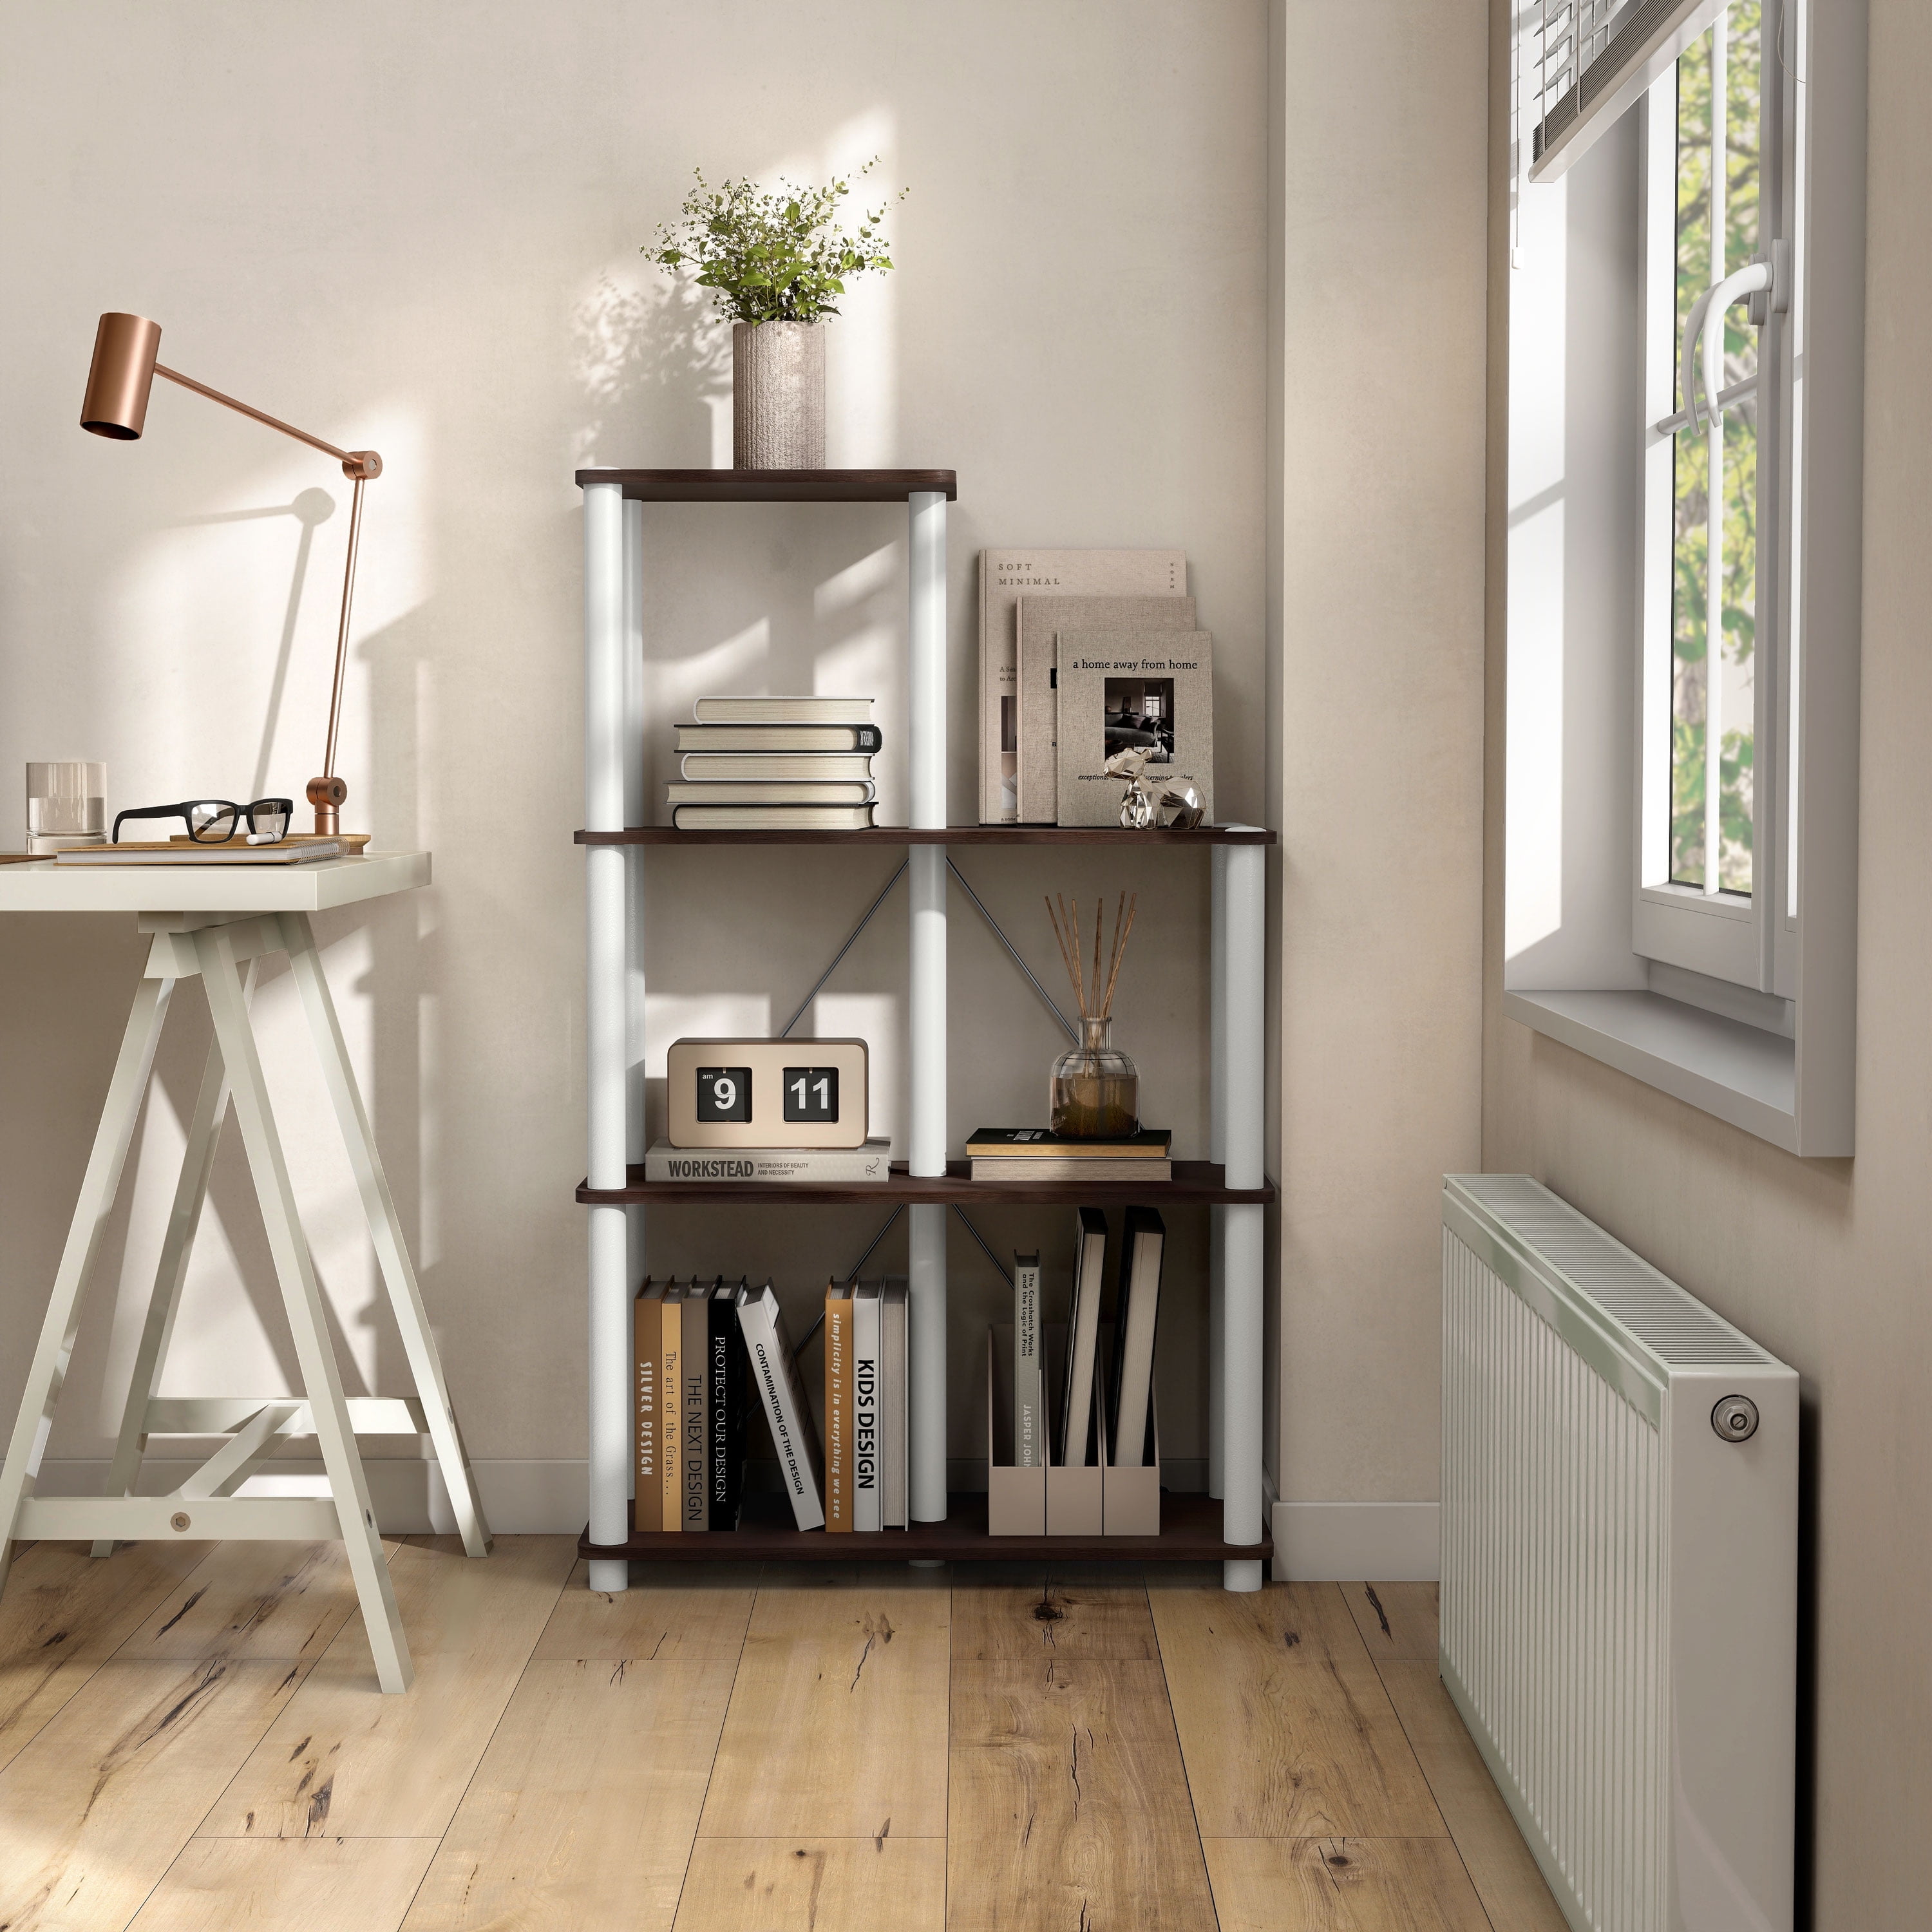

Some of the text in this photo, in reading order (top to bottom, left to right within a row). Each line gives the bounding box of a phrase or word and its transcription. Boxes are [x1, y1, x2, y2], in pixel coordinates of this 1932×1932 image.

[1081, 659, 1110, 668] home
[1113, 661, 1139, 671] away
[1141, 659, 1166, 668] from
[1168, 659, 1198, 669] home
[714, 1077, 828, 1110] 9 11
[668, 1160, 754, 1177] WORKSTEAD
[831, 1313, 842, 1375] simplicity
[666, 1351, 676, 1370] The
[666, 1377, 674, 1395] art
[833, 1379, 842, 1389] is
[666, 1402, 676, 1415] of
[833, 1394, 842, 1405] in
[640, 1361, 652, 1475] SILVER DESIGN
[666, 1422, 676, 1440] the
[715, 1336, 726, 1502] PROTECT OUR DESIGN
[755, 1343, 804, 1495] CONTAMINATION OF THE DESIGN
[858, 1359, 874, 1489] KIDS DESIGN
[1023, 1405, 1032, 1441] JASPER
[688, 1374, 703, 1520] THE NEXT DESIGN
[831, 1409, 842, 1475] everything
[833, 1482, 840, 1494] we
